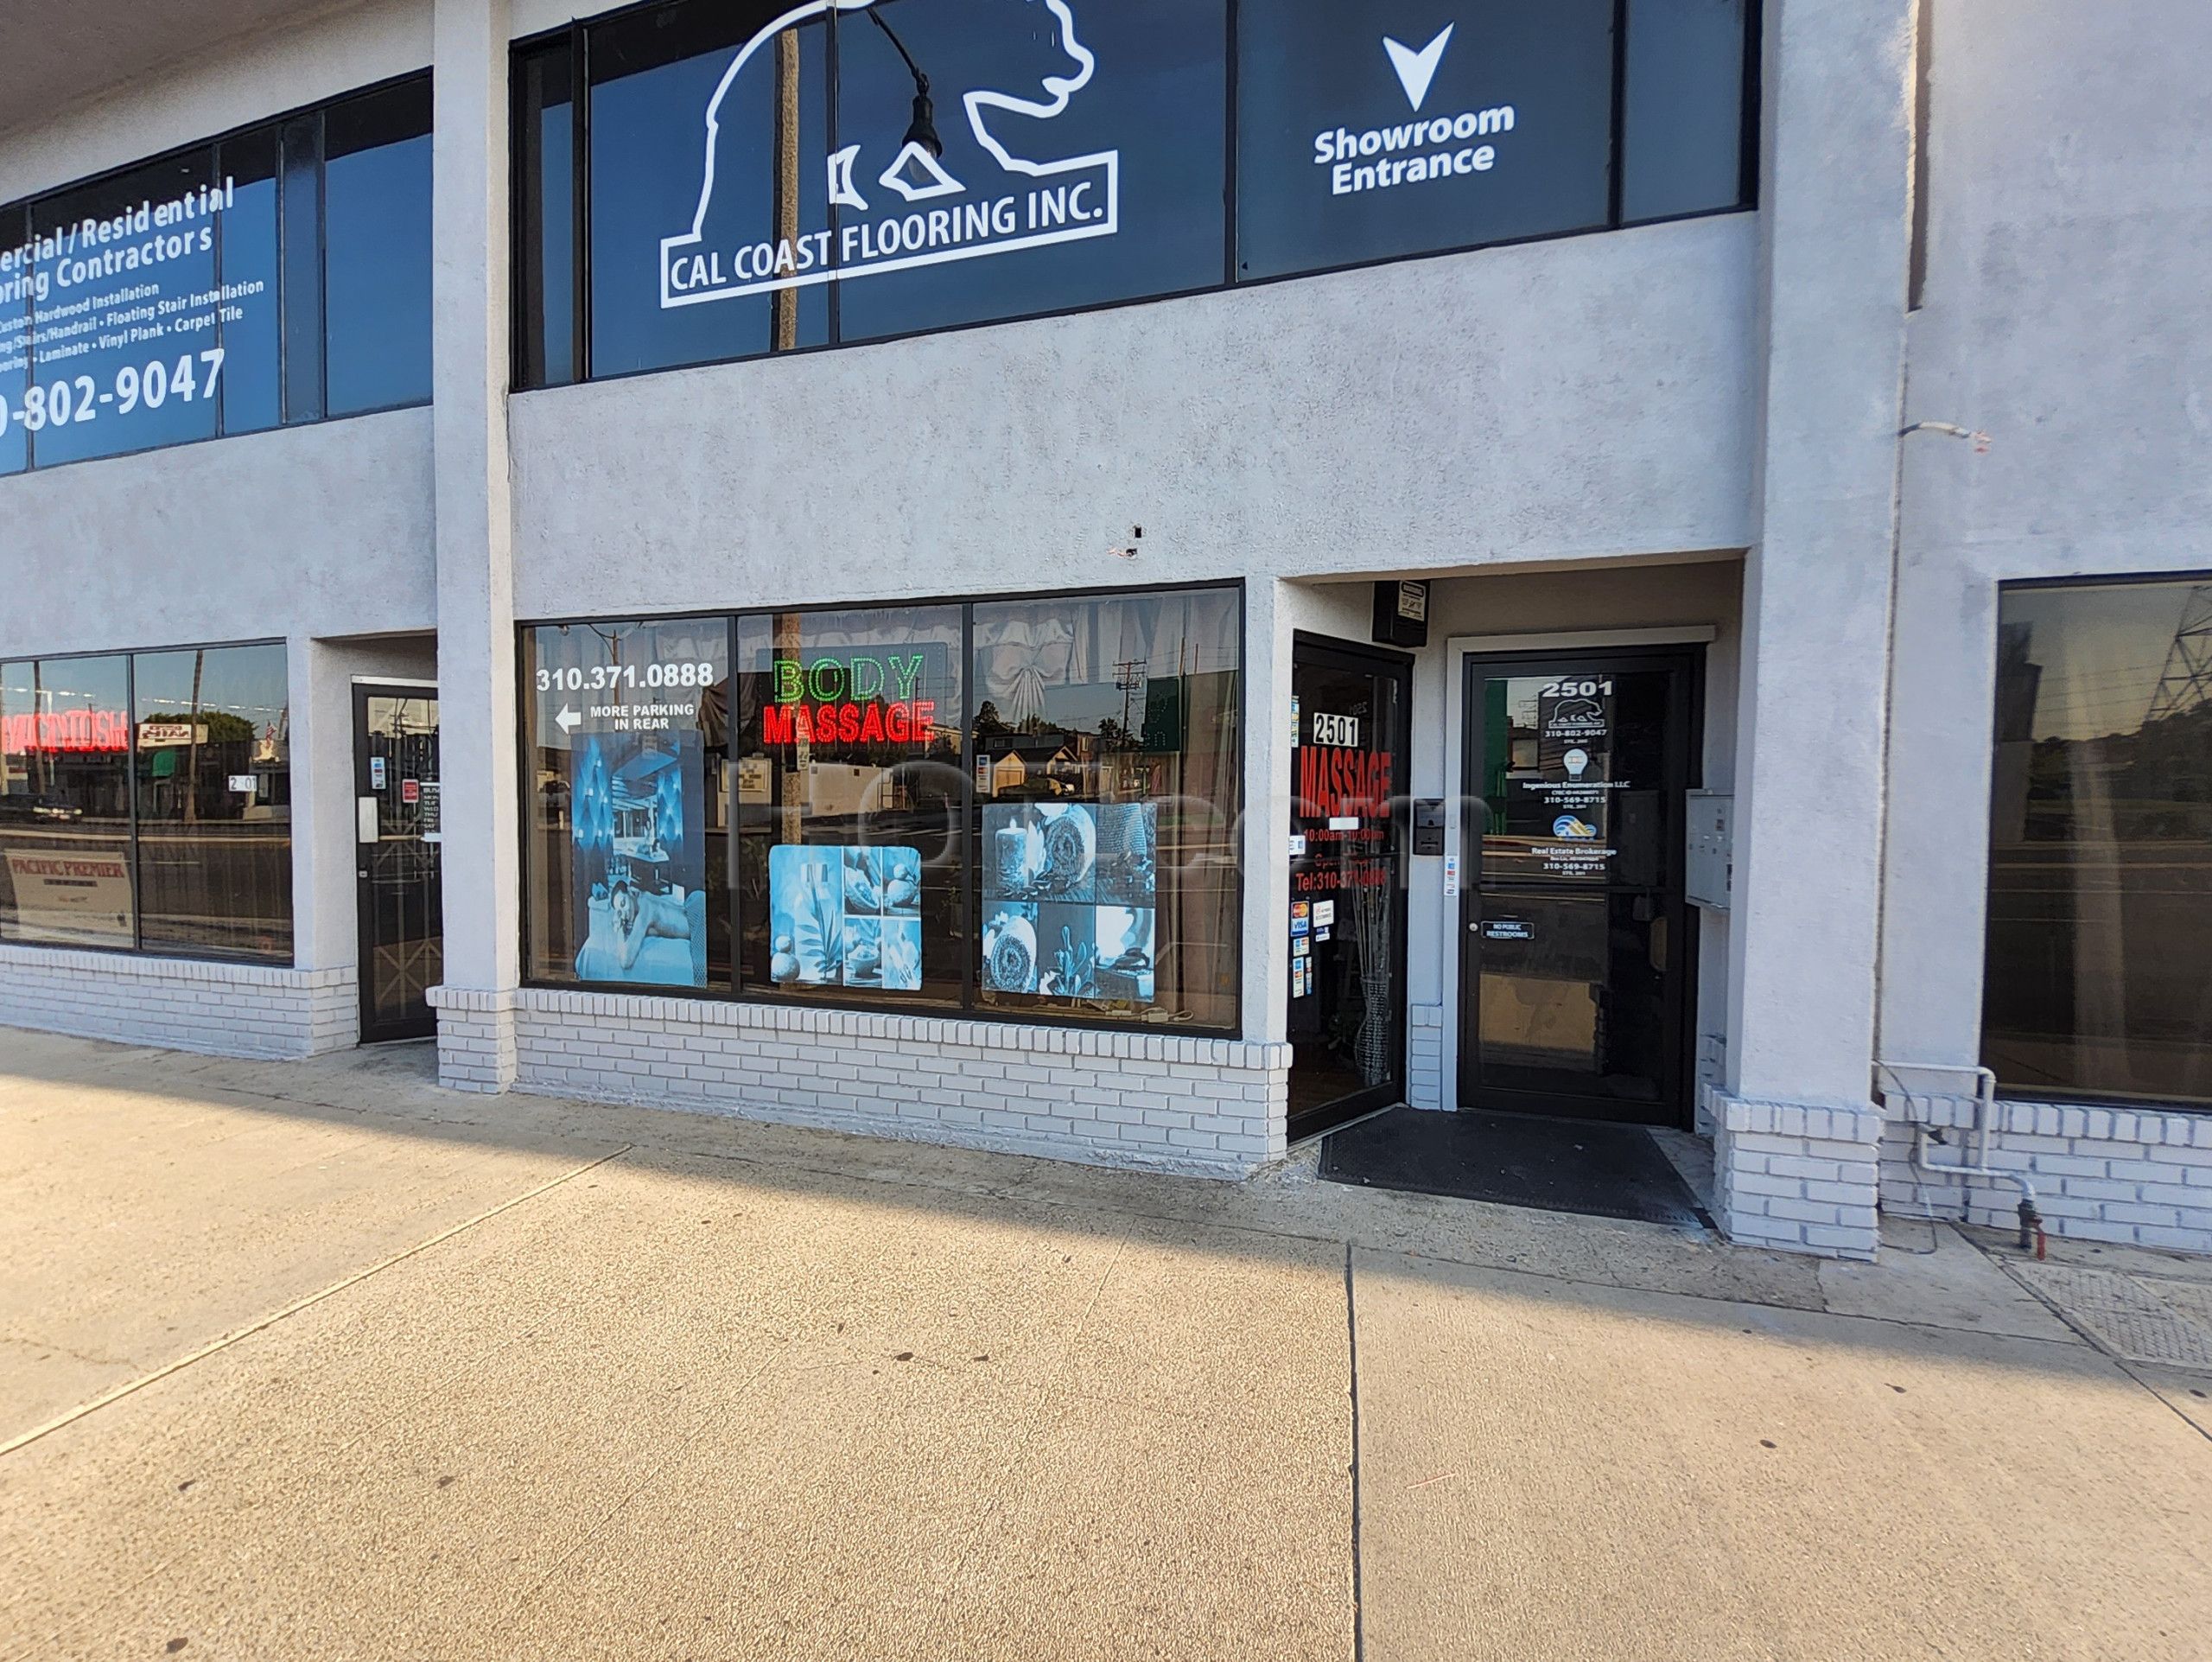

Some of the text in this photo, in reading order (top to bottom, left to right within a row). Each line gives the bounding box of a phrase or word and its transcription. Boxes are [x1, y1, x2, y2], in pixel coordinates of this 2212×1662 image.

[1313, 105, 1515, 164] Showroom
[1332, 145, 1495, 195] Entrance
[82, 175, 233, 248] Residential
[56, 226, 212, 287] Contractors
[671, 181, 1103, 290] CAL COAST FLOORING INC.
[35, 297, 90, 324] Hardwood
[92, 283, 159, 310] Installation
[106, 306, 155, 328] Floating
[157, 296, 187, 315] Stair
[190, 280, 264, 308] Installation
[99, 329, 128, 349] Vinyl
[130, 322, 164, 342] Plank
[175, 312, 215, 332] Carpet
[219, 305, 243, 322] Tile
[536, 663, 714, 691] 310.371.0888
[773, 654, 924, 704] BODY
[1541, 680, 1612, 697] 2501
[589, 704, 695, 718] MORE PARKING
[614, 718, 670, 730] IN REAR
[763, 700, 935, 744] MASSAGE
[1315, 714, 1356, 746] 2501
[1300, 745, 1392, 818] MASSAGE
